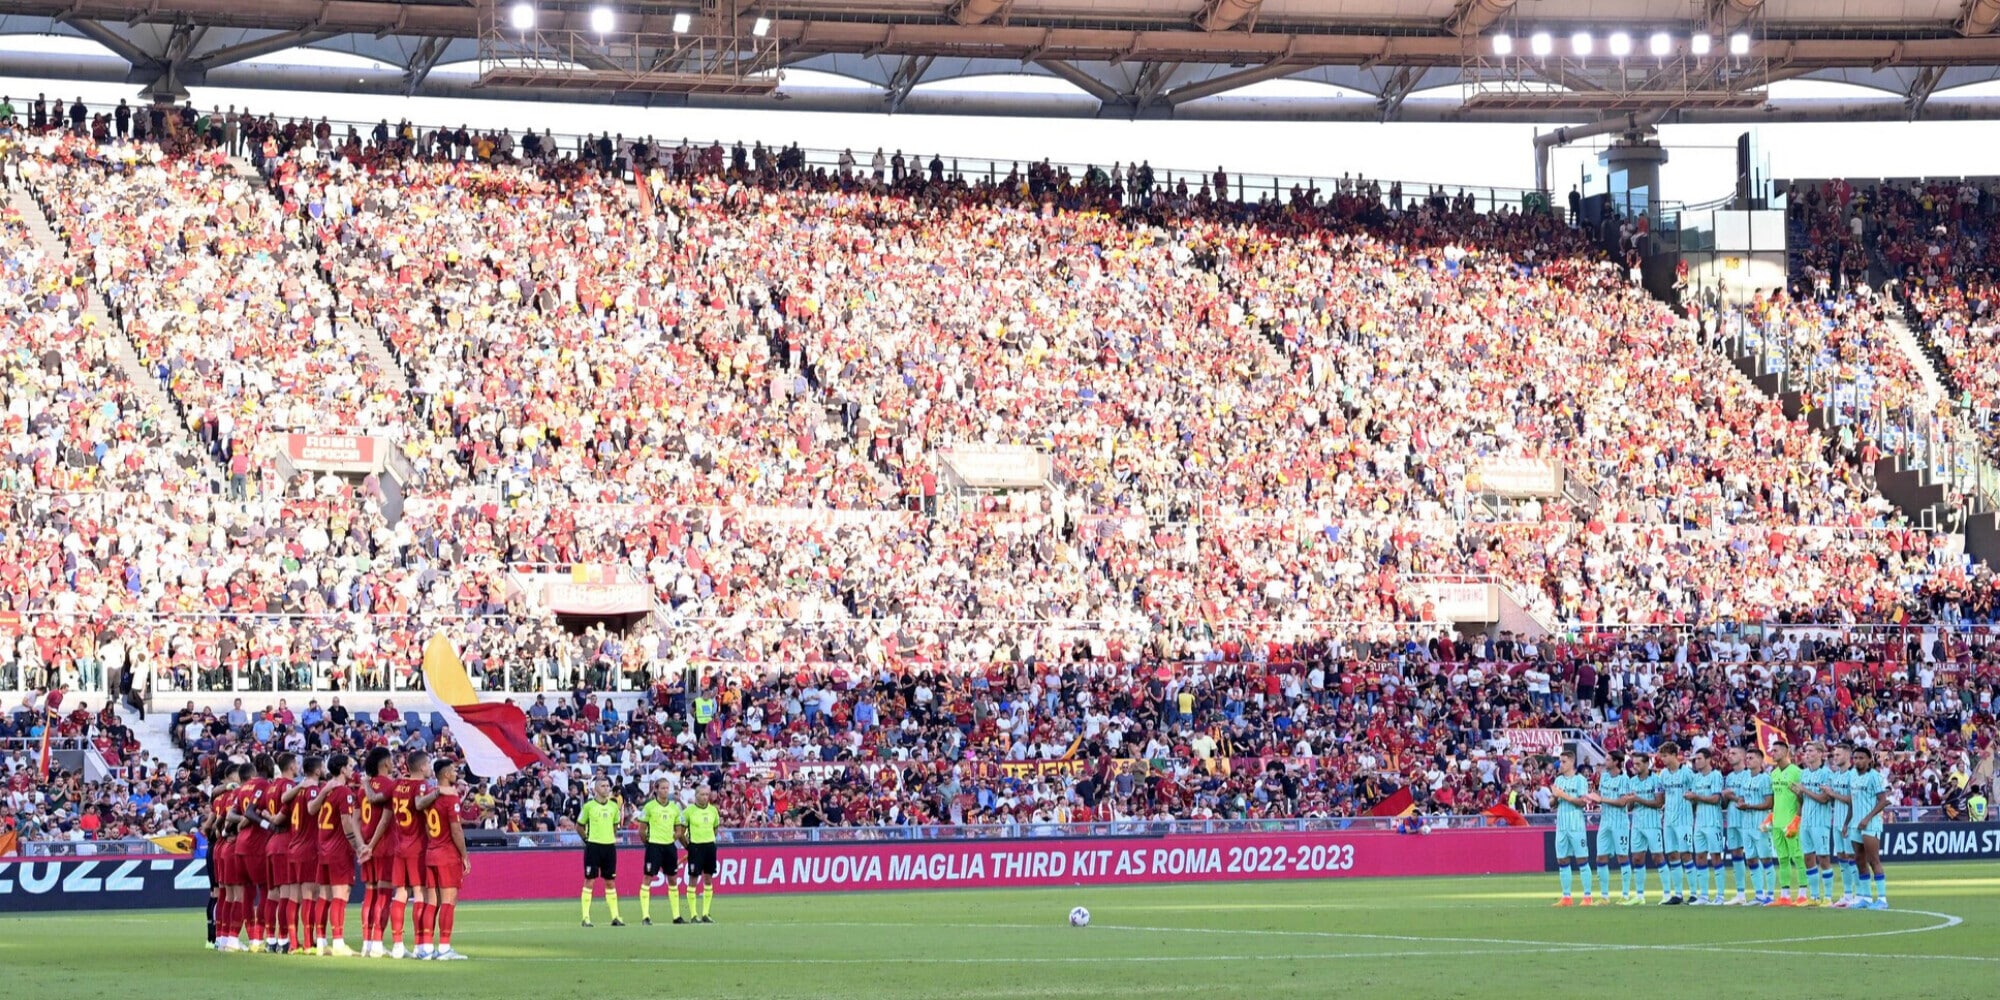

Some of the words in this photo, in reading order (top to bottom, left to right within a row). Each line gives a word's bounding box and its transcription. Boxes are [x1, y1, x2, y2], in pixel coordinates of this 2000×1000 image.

[306, 436, 357, 449] ROMA
[424, 808, 441, 838] 9
[1893, 832, 1918, 855] AS
[1922, 830, 1977, 854] ROMA
[753, 858, 785, 885] LA
[792, 855, 884, 884] NUOVA
[888, 853, 985, 881] MAGLIA
[991, 851, 1066, 878] THIRD
[1072, 850, 1113, 876] KIT
[1115, 850, 1146, 875] AS
[1152, 848, 1222, 874] ROMA
[1227, 844, 1354, 873] 2022-2023
